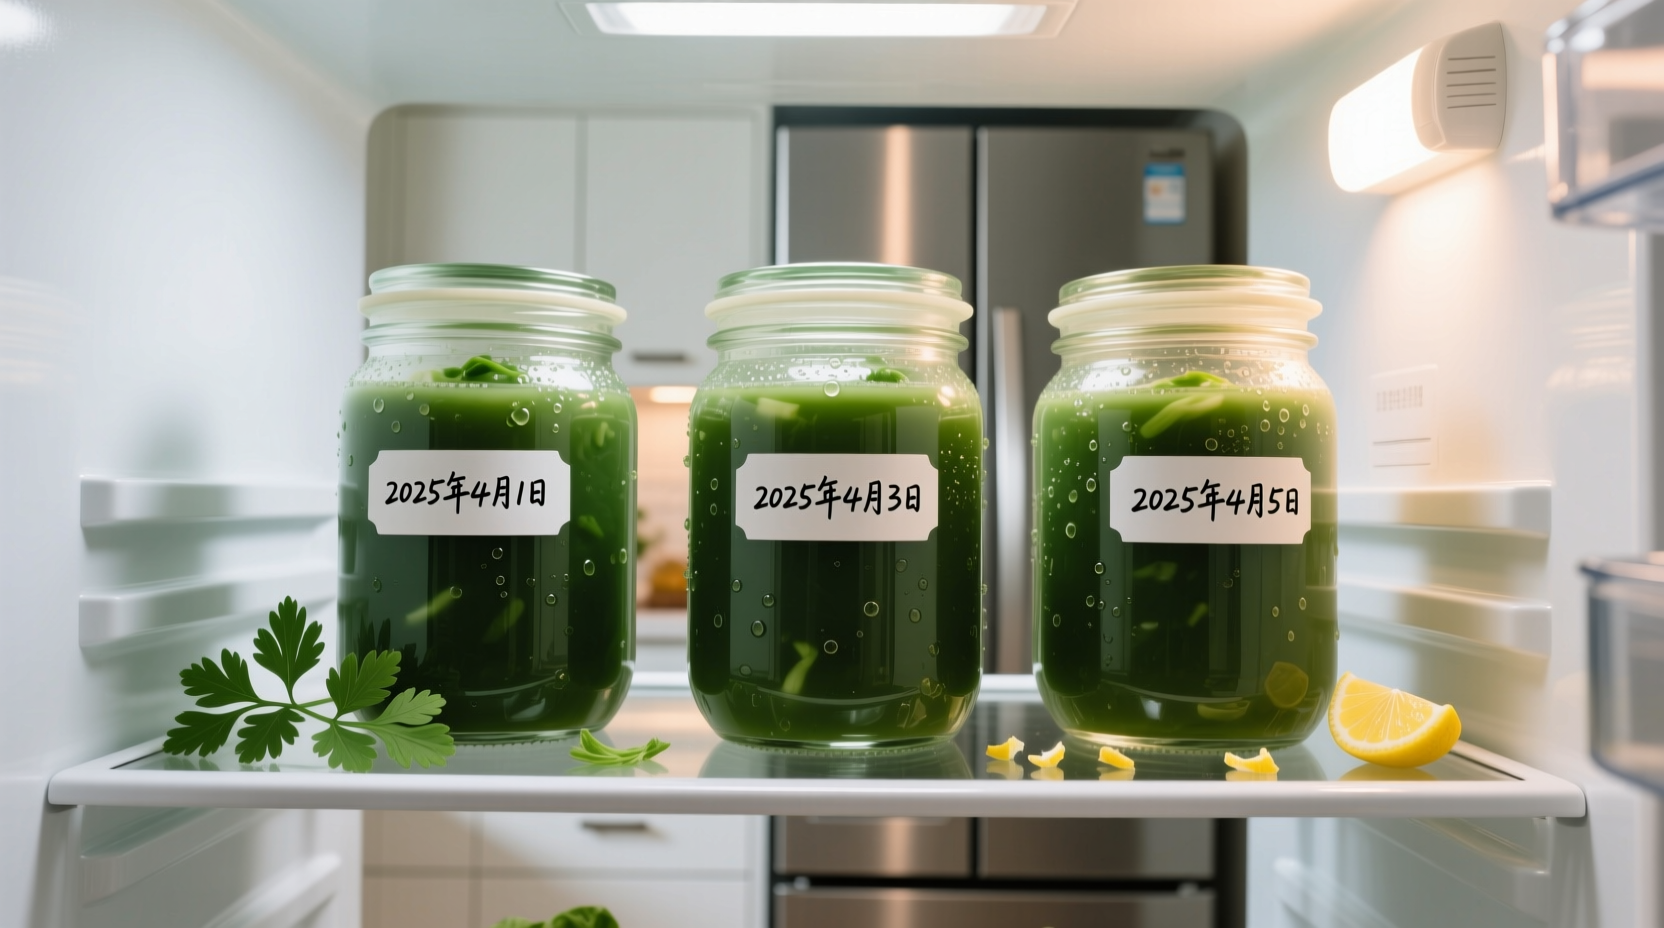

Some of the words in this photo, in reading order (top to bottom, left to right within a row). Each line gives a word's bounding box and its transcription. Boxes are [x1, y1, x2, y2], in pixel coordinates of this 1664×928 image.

[385, 471, 545, 514] 2025年4月1日
[754, 476, 920, 520] 2025年4月3日
[1132, 479, 1299, 521] 2025年4月5日
